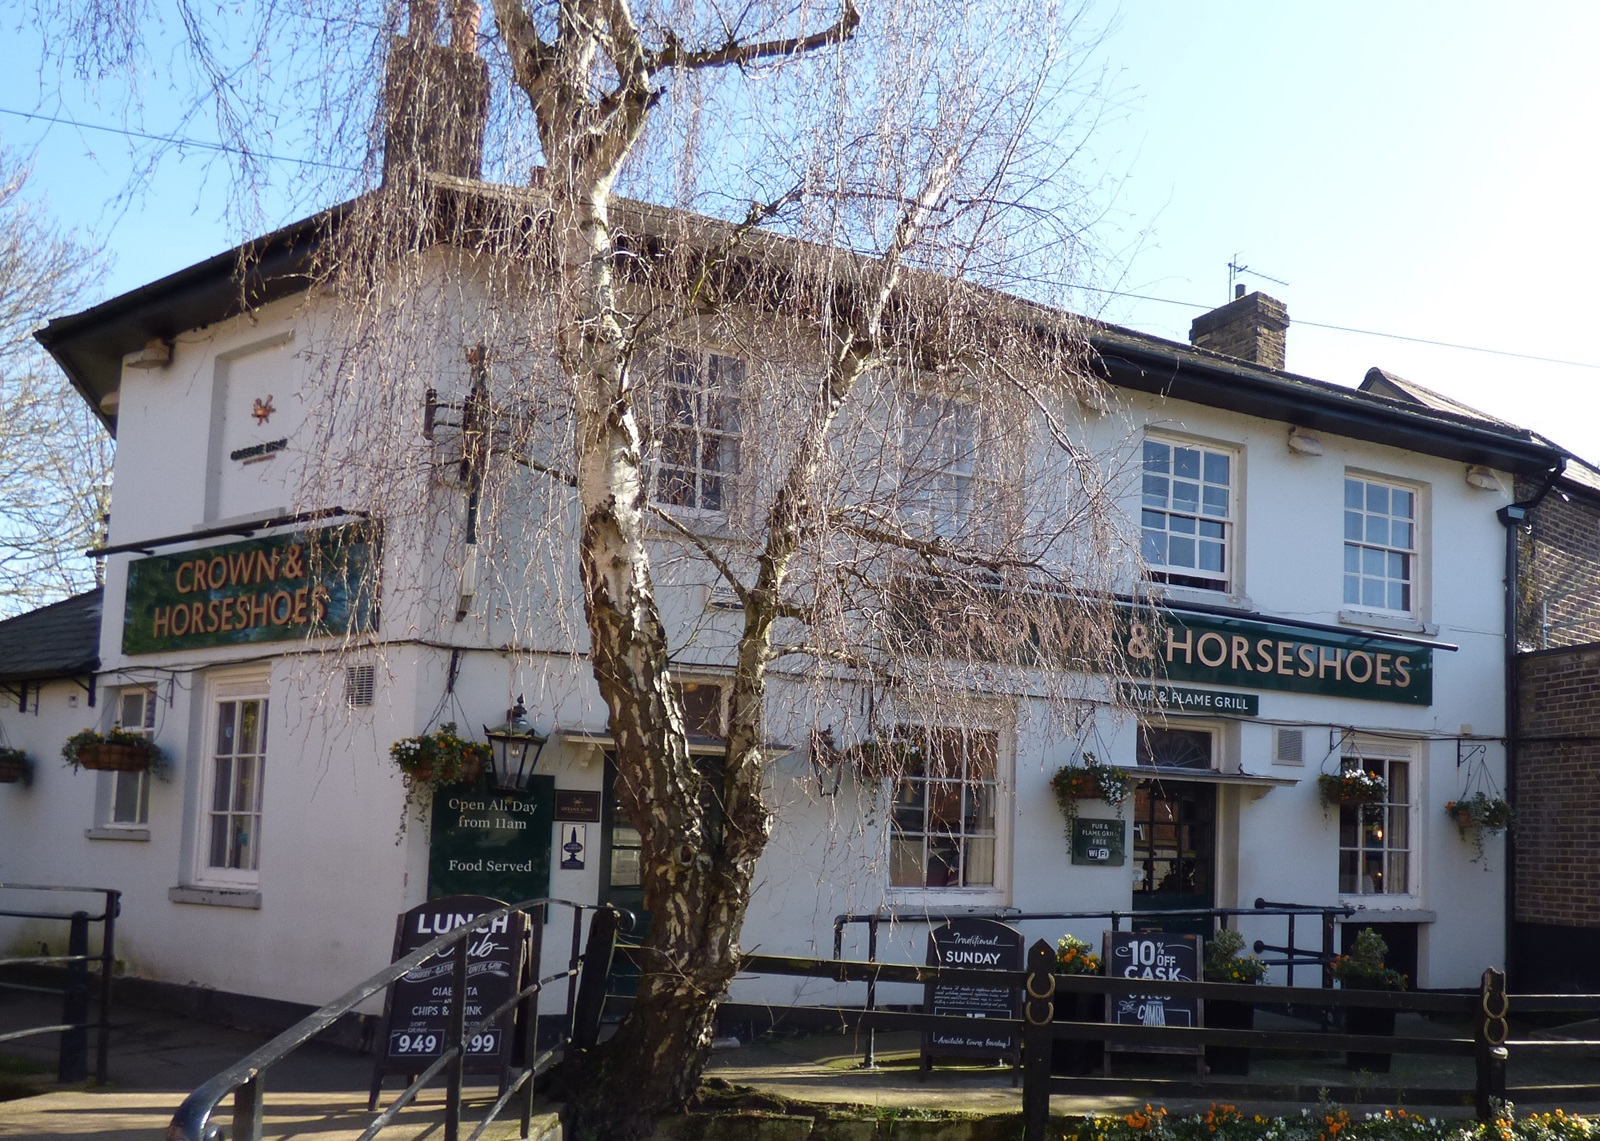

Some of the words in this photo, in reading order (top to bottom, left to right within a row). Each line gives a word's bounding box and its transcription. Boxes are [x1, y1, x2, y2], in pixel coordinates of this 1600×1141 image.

[176, 547, 279, 594] CROWN
[284, 543, 304, 579] &
[153, 585, 330, 638] HORSESHOES
[1127, 622, 1155, 661] &
[1165, 627, 1412, 689] HORSESHOES
[1158, 690, 1168, 703] &
[1171, 692, 1212, 707] FLAME
[1214, 695, 1249, 711] GRILL
[448, 798, 485, 813] Open
[512, 800, 538, 815] Day
[458, 815, 491, 829] from
[495, 818, 527, 830] 11am
[448, 859, 483, 872] Food
[486, 860, 532, 872] Served
[953, 932, 1000, 947] Traditional
[945, 950, 1001, 965] SUNDAY
[1157, 955, 1176, 967] OFF
[1124, 965, 1182, 981] CASK
[411, 1005, 439, 1016] CHIPS
[442, 1006, 450, 1016] &
[398, 1034, 437, 1053] 9.49
